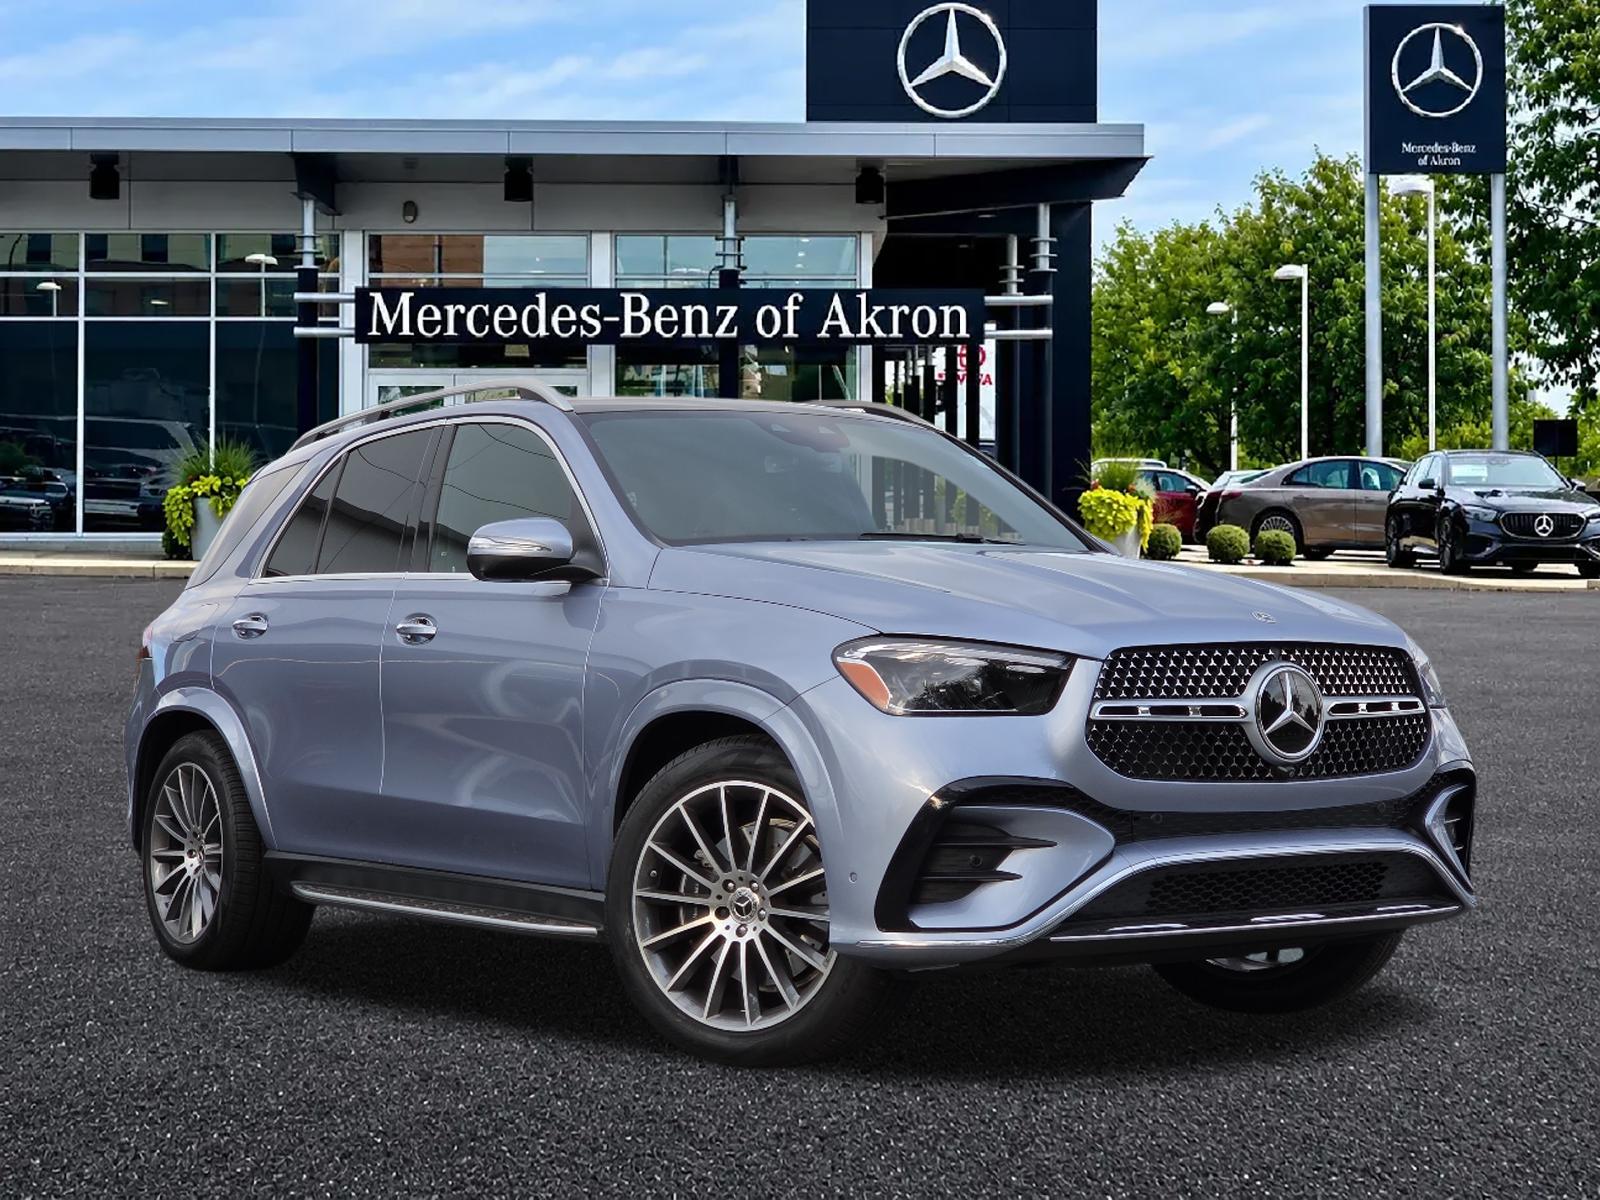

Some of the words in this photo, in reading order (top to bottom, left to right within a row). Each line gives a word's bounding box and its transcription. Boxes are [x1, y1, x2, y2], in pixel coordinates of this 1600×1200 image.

[1401, 141, 1476, 153] Mercedes-Benz
[1418, 155, 1428, 166] of
[1430, 155, 1461, 166] Akron
[367, 291, 738, 338] Mercedes-Benz
[755, 291, 804, 338] of
[816, 291, 971, 338] Akron
